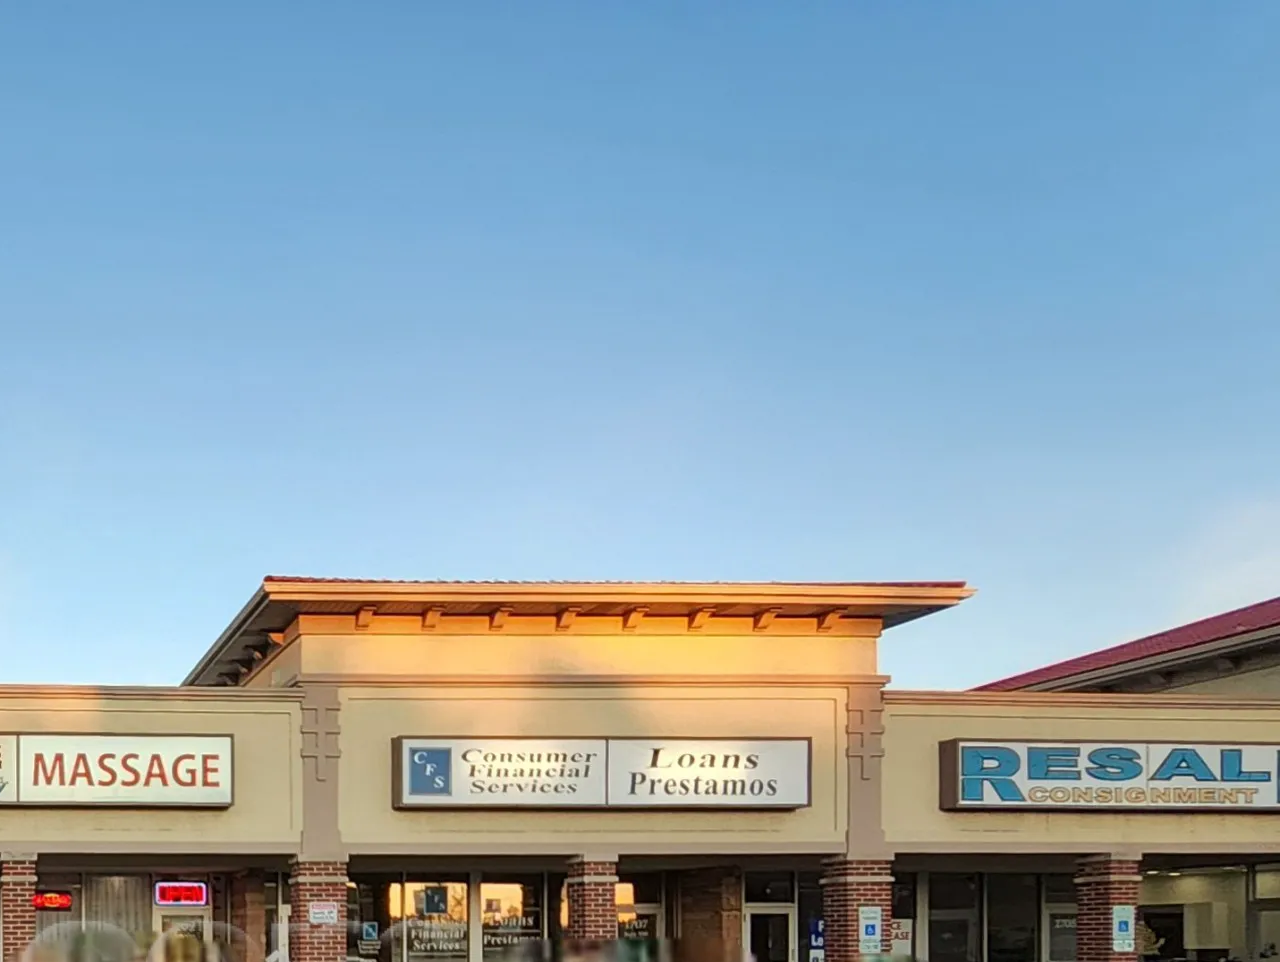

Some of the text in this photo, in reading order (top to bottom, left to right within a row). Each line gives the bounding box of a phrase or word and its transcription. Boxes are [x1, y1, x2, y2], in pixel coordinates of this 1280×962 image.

[461, 748, 597, 763] Consumer
[647, 747, 760, 769] Loans
[33, 753, 221, 787] MASSAGE
[468, 764, 590, 778] Financial
[470, 780, 578, 794] Services
[628, 771, 778, 796] Prestamos
[1028, 786, 1259, 804] CONSIGNMENT
[158, 886, 204, 902] OPEN
[411, 928, 464, 939] Financial
[413, 940, 460, 951] Services
